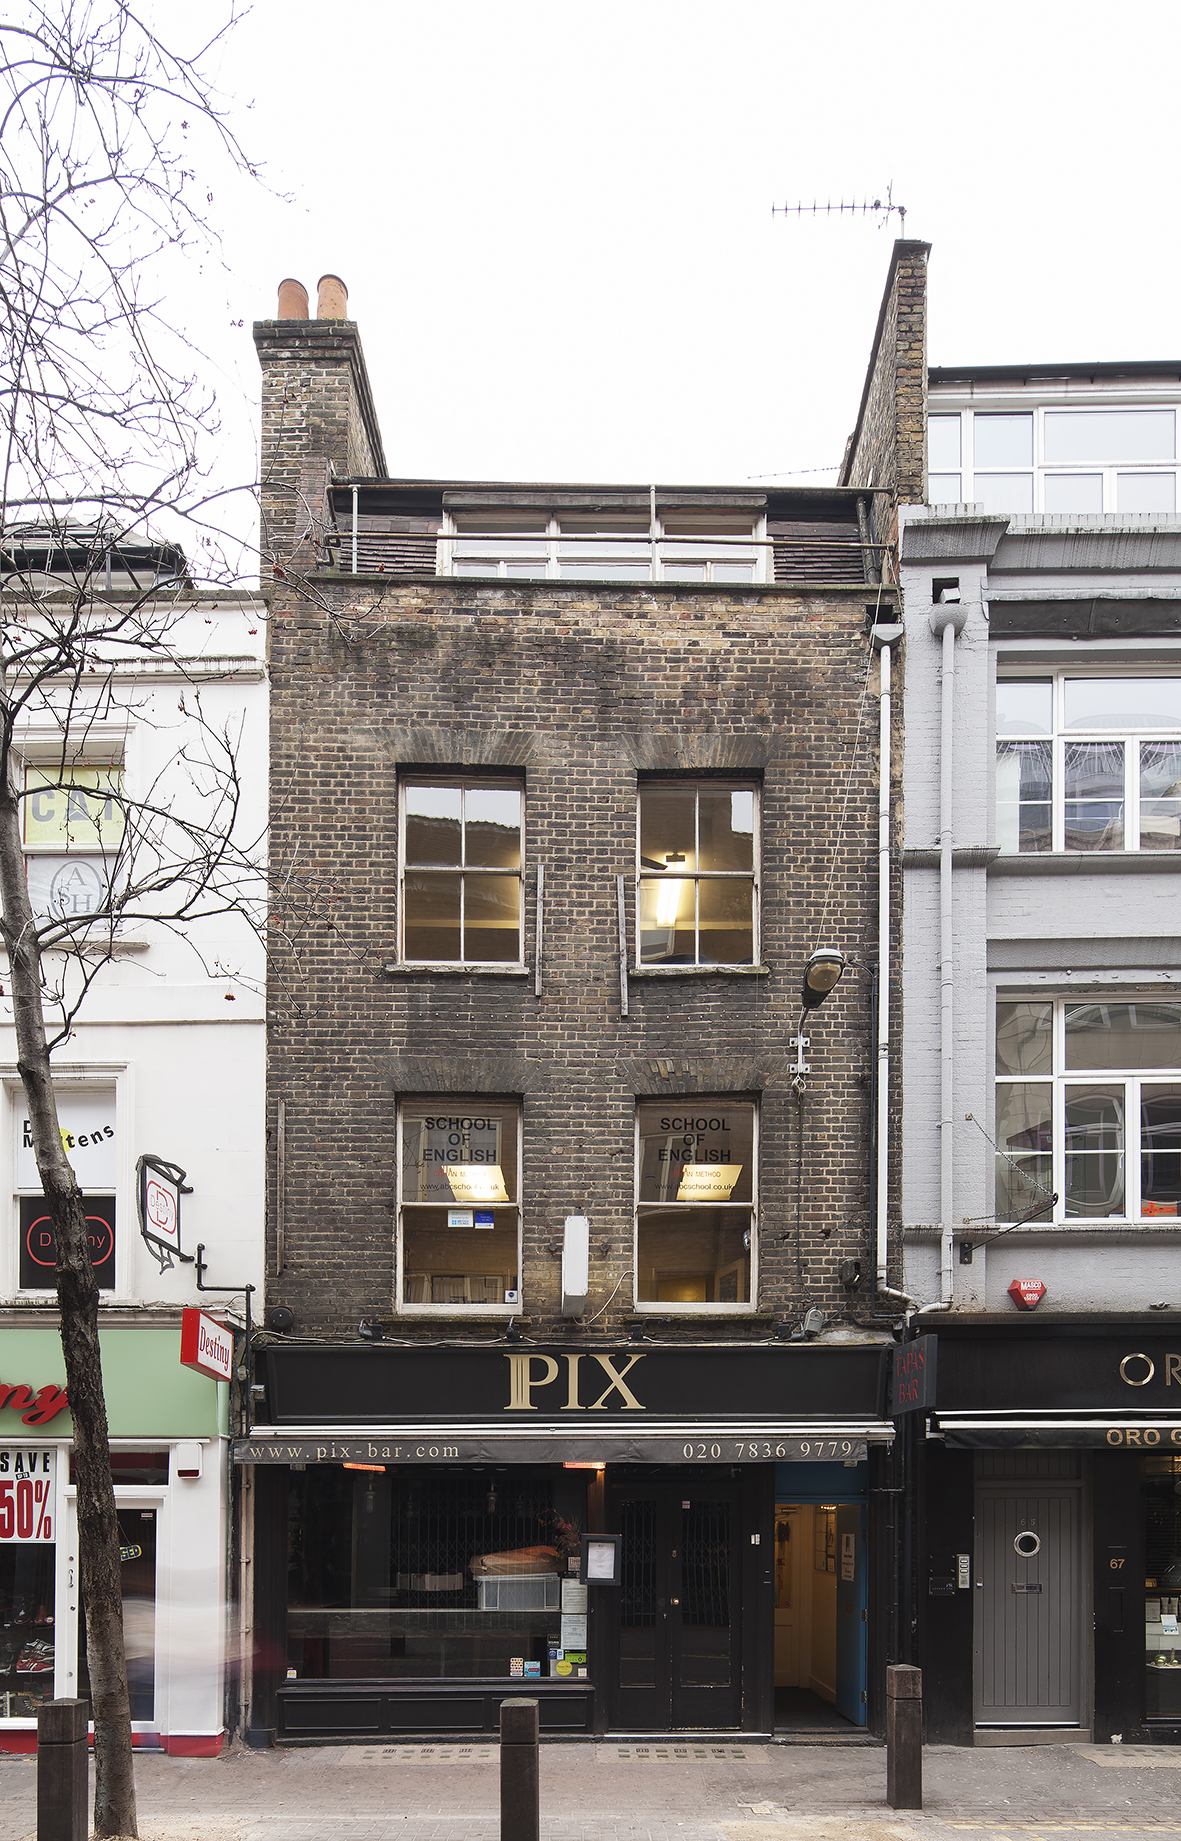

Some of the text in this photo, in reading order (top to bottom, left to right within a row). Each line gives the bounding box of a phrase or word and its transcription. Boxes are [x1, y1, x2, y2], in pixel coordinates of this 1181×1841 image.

[32, 788, 119, 822] CAT
[425, 1117, 497, 1130] SCHOOL
[660, 1118, 731, 1131] SCHOOL
[23, 1125, 115, 1148] Mtens
[448, 1133, 471, 1146] OF
[683, 1134, 706, 1146] OF
[423, 1149, 497, 1162] ENGLISH
[658, 1149, 731, 1162] ENGLISH
[200, 1325, 230, 1372] Destiny
[895, 1346, 925, 1378] TAPAS
[502, 1353, 648, 1410] PIX
[898, 1378, 919, 1404] BAR
[1106, 1428, 1161, 1446] ORO
[250, 1442, 460, 1462] www.pix-bar.com
[682, 1441, 853, 1459] 020 7836 9779
[0, 1452, 50, 1473] SAVE
[0, 1480, 52, 1539] 50%
[120, 1545, 140, 1560] SED
[1109, 1558, 1126, 1569] 67
